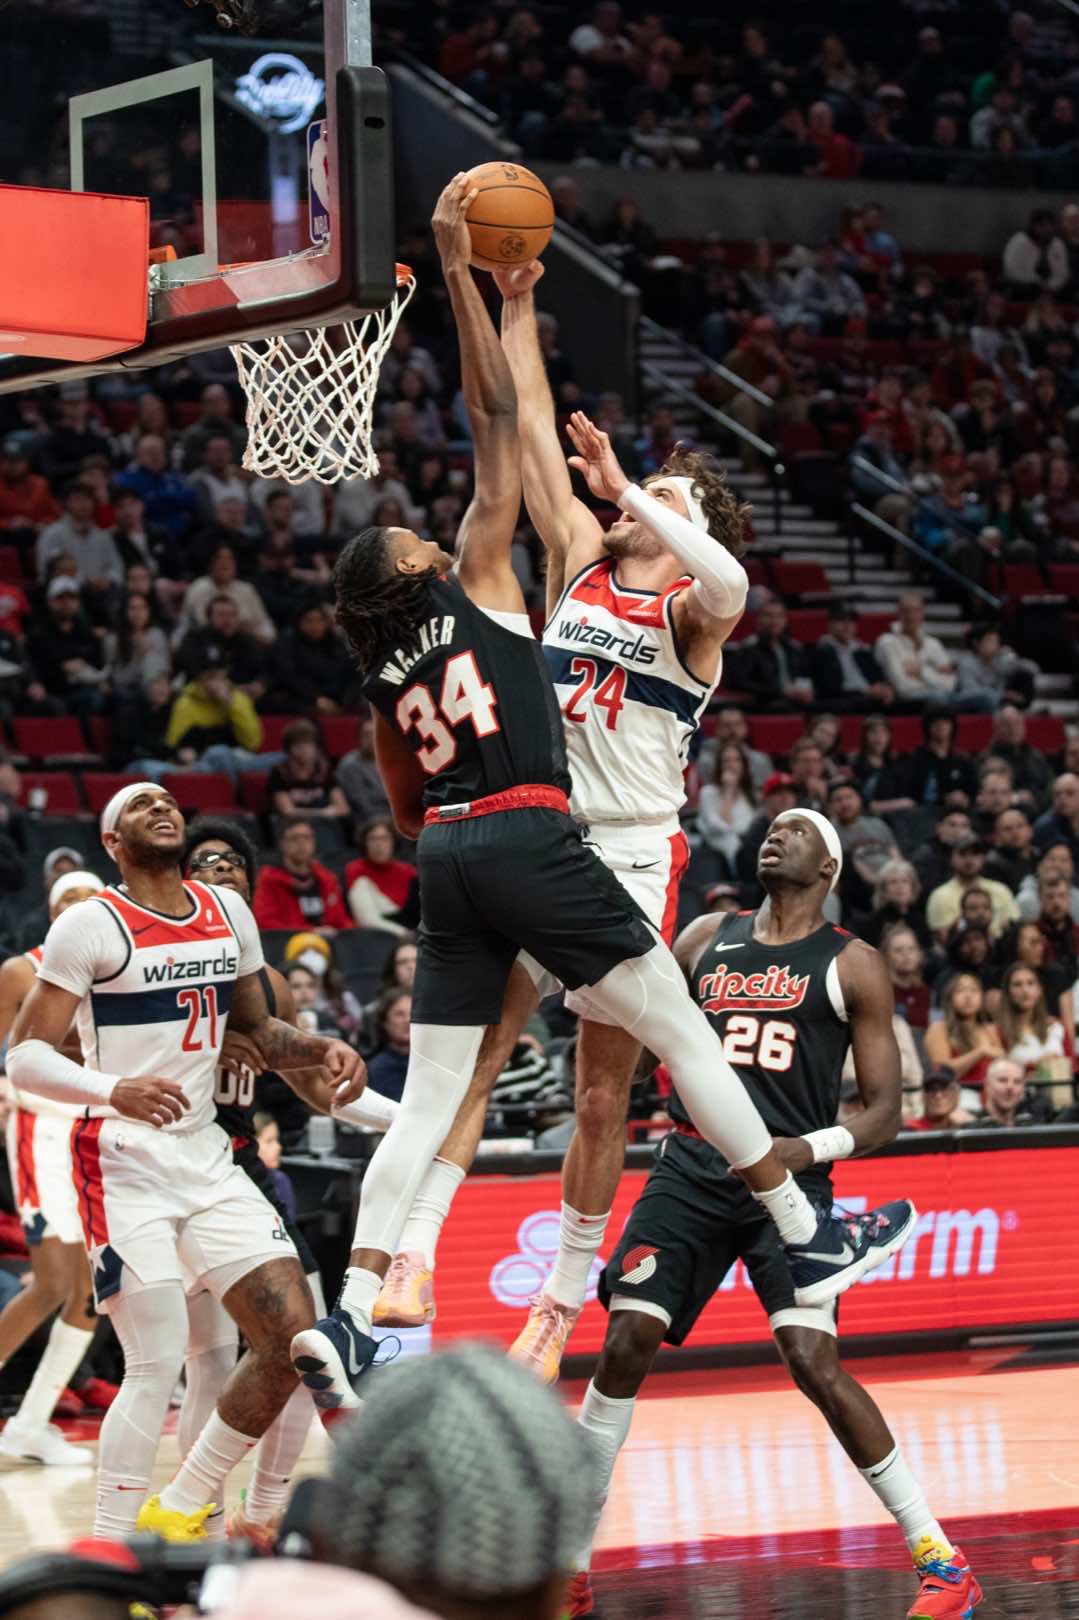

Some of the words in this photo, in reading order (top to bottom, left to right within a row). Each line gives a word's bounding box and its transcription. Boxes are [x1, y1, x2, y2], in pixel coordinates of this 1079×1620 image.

[558, 617, 660, 664] wizards
[396, 649, 500, 776] 34
[565, 657, 627, 731] 24
[143, 947, 236, 983] wizards
[698, 963, 811, 1015] ripcity
[176, 985, 218, 1053] 21
[722, 1014, 797, 1073] 26
